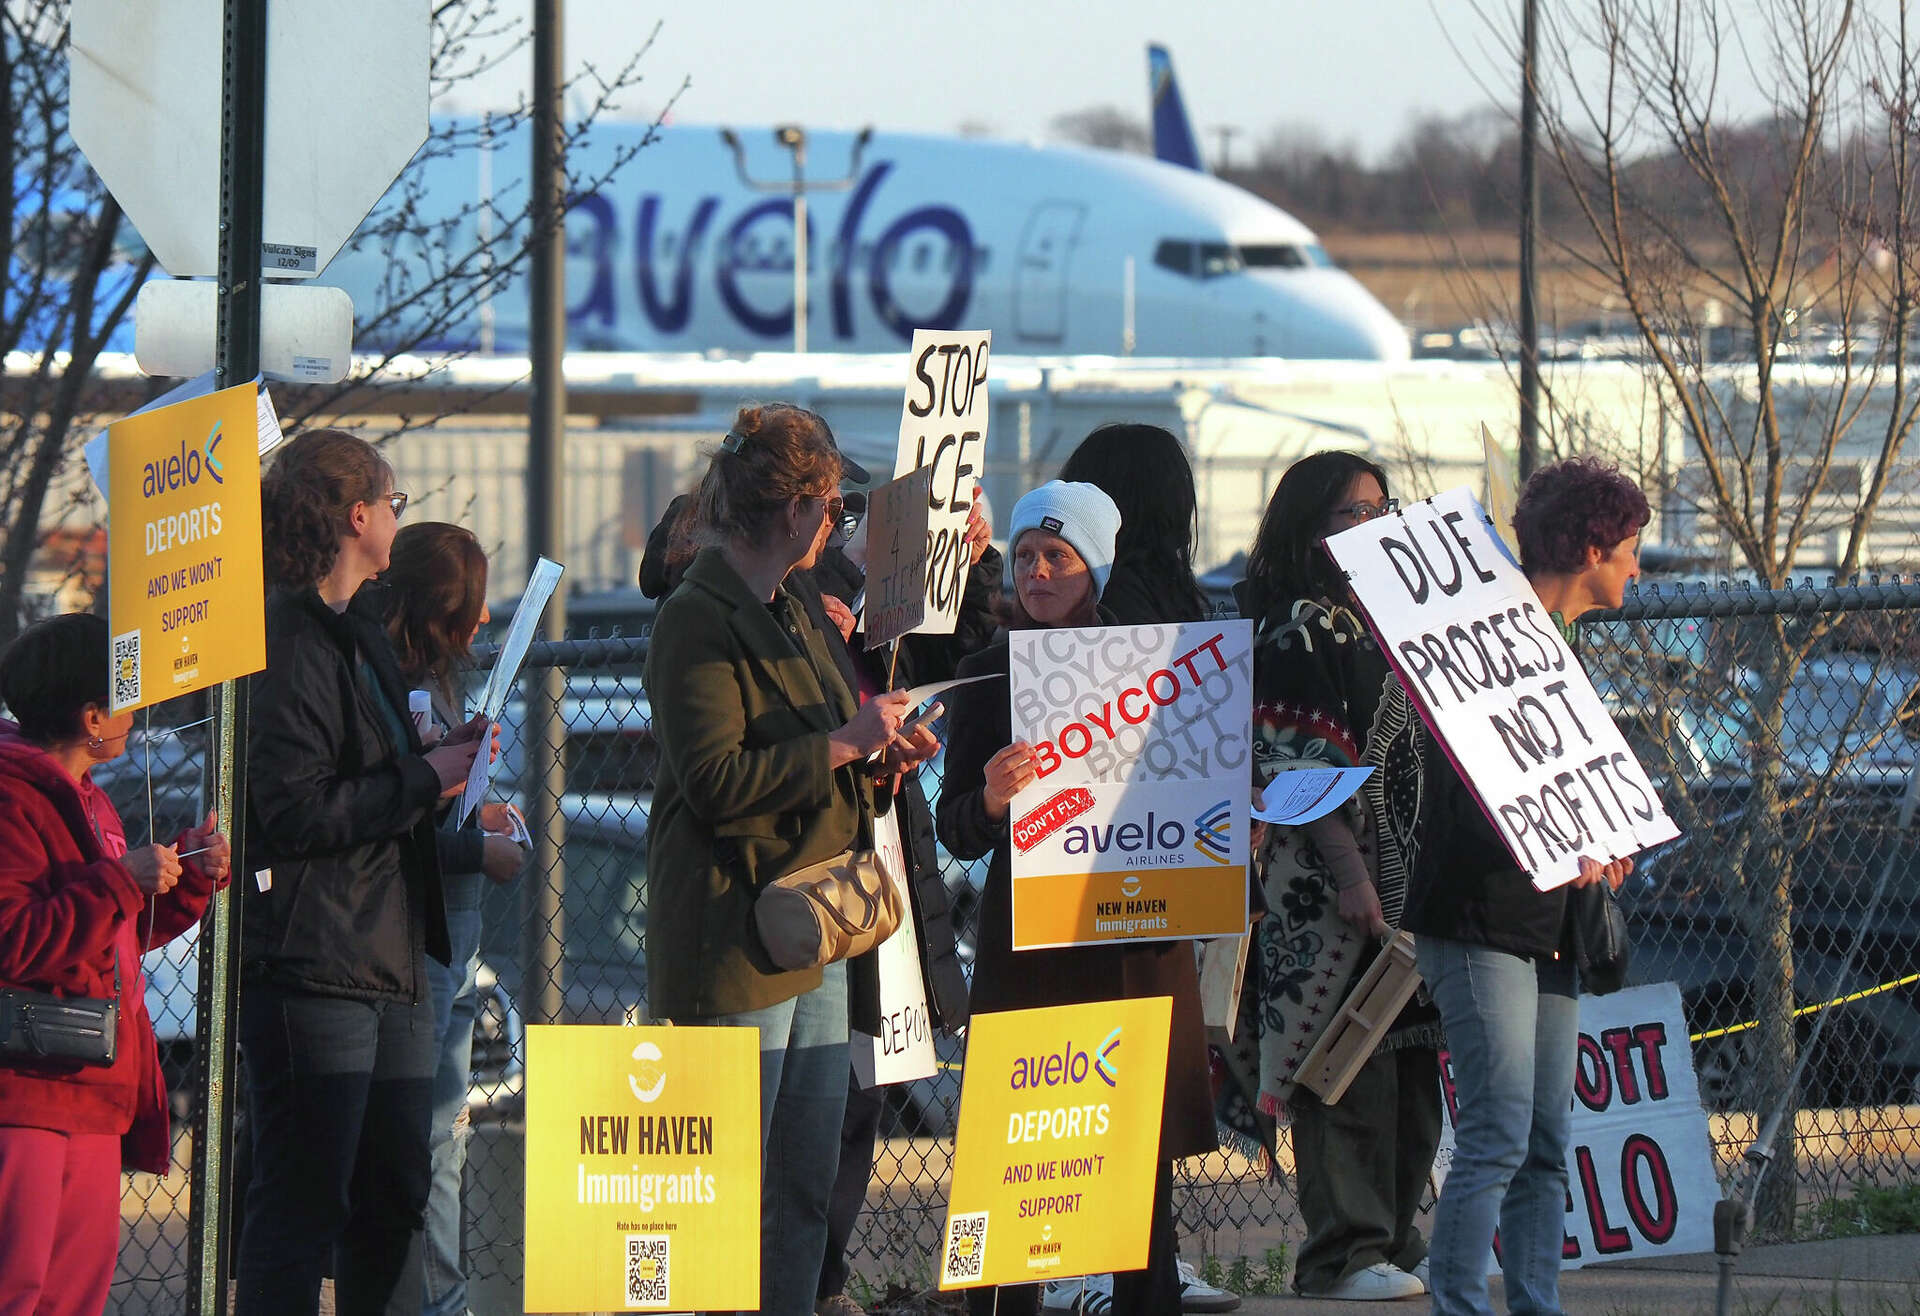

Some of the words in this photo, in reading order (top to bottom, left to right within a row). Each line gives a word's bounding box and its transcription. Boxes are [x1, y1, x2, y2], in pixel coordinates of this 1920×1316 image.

[262, 243, 291, 255] Vulcan
[294, 246, 317, 259] Signs
[277, 258, 301, 268] 12/09
[527, 160, 978, 340] avelo
[909, 340, 989, 418] STOP
[143, 440, 201, 498] avelo
[145, 501, 223, 556] DEPORTS
[147, 574, 169, 599] AND
[171, 568, 187, 592] WE
[189, 556, 222, 587] WON'T
[1379, 511, 1496, 605] DUE
[161, 599, 210, 633] SUPPORT
[1399, 602, 1567, 710] PROCESS
[1032, 633, 1228, 779] BOYCOTT
[1489, 680, 1593, 773] NOT
[1016, 809, 1056, 842] DON'T
[1057, 793, 1082, 815] FLY
[1063, 811, 1186, 855] avelo
[1499, 752, 1654, 873] PROFITS
[1126, 854, 1185, 866] AIRLINES
[1096, 916, 1168, 933] Immigrants
[1097, 902, 1122, 915] NEW
[1127, 899, 1167, 914] HAVEN
[1010, 1041, 1089, 1090] avelo
[1573, 1022, 1669, 1112] OTT
[580, 1116, 630, 1155] NEW
[638, 1116, 713, 1155] HAVEN
[1007, 1104, 1110, 1144] DEPORTS
[577, 1163, 716, 1213] Immigrants
[1003, 1164, 1032, 1185] AND
[1036, 1161, 1057, 1181] WE
[1061, 1154, 1105, 1179] WON'T
[616, 1221, 629, 1231] Hate
[631, 1221, 640, 1231] has
[642, 1223, 649, 1231] no
[650, 1221, 664, 1232] place
[665, 1221, 677, 1231] here
[1018, 1193, 1083, 1218] SUPPORT
[1029, 1244, 1041, 1255] NEW
[1043, 1242, 1062, 1254] HAVEN
